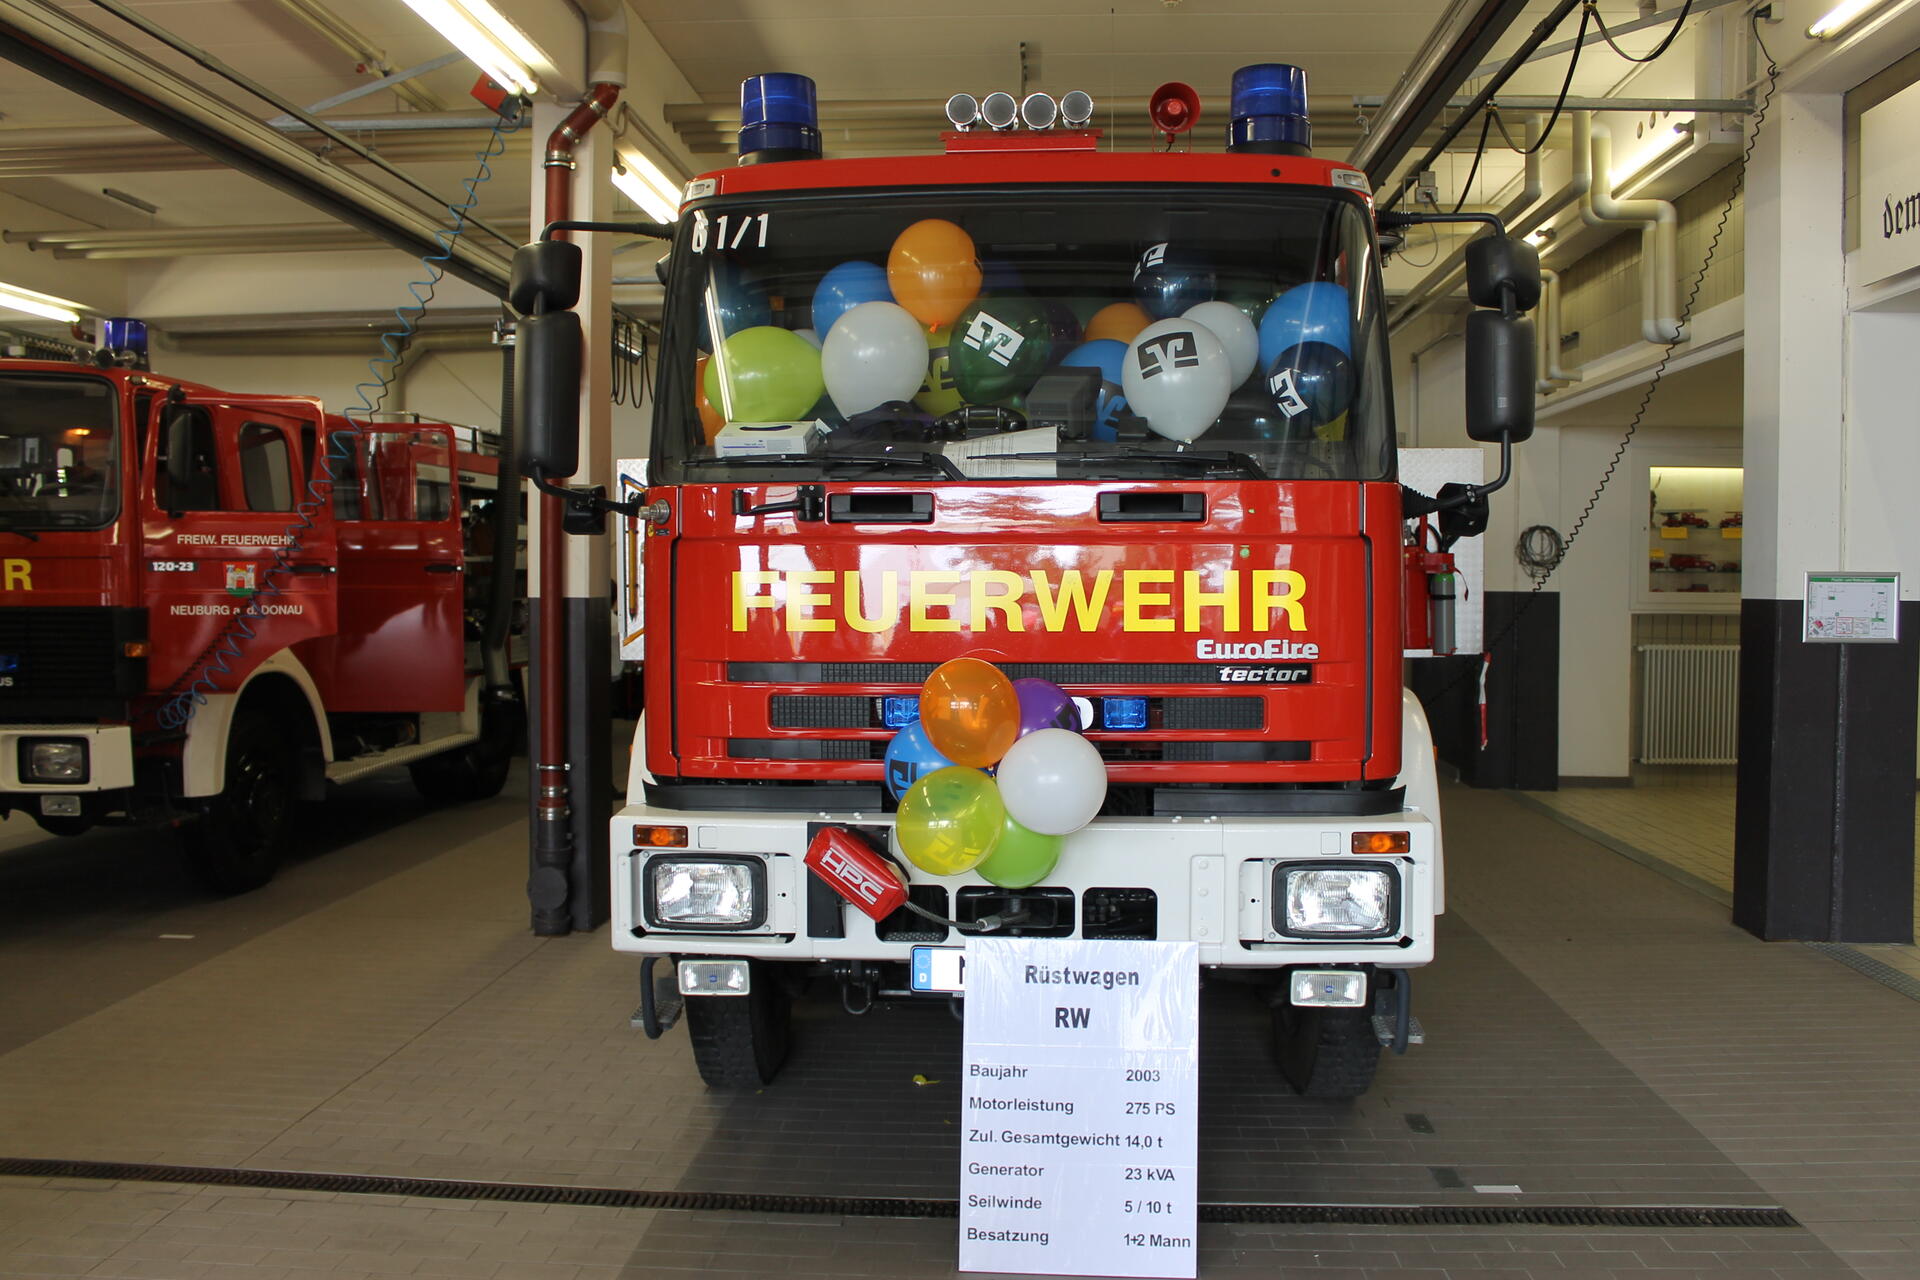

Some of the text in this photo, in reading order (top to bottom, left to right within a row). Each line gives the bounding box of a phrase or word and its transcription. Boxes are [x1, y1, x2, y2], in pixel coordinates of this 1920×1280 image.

[692, 212, 769, 253] 61/1
[177, 535, 296, 545] FREIW. FEUERWEHR
[3, 558, 32, 591] R
[152, 561, 194, 571] 120-23
[170, 605, 230, 616] NEUBURG
[261, 605, 303, 616] DONAU
[731, 569, 1308, 632] FEUERWEHR
[1196, 639, 1319, 660] EuroFire
[1220, 666, 1308, 682] tector
[820, 847, 885, 905] HPC
[919, 972, 928, 983] D
[1025, 964, 1140, 990] Rüstwagen
[1055, 1007, 1091, 1029] RW
[970, 1064, 1161, 1083] Baujahr 2003
[969, 1096, 1176, 1116] Motorleistung 275 PS
[968, 1129, 1163, 1151] Zul. Gesamtgewicht 14,0 t
[968, 1162, 1176, 1182] Generator 23 kVA
[968, 1194, 1173, 1215] Seilwinde 5 / 10 t
[967, 1227, 1191, 1248] Besatzung 1+2 Mann
